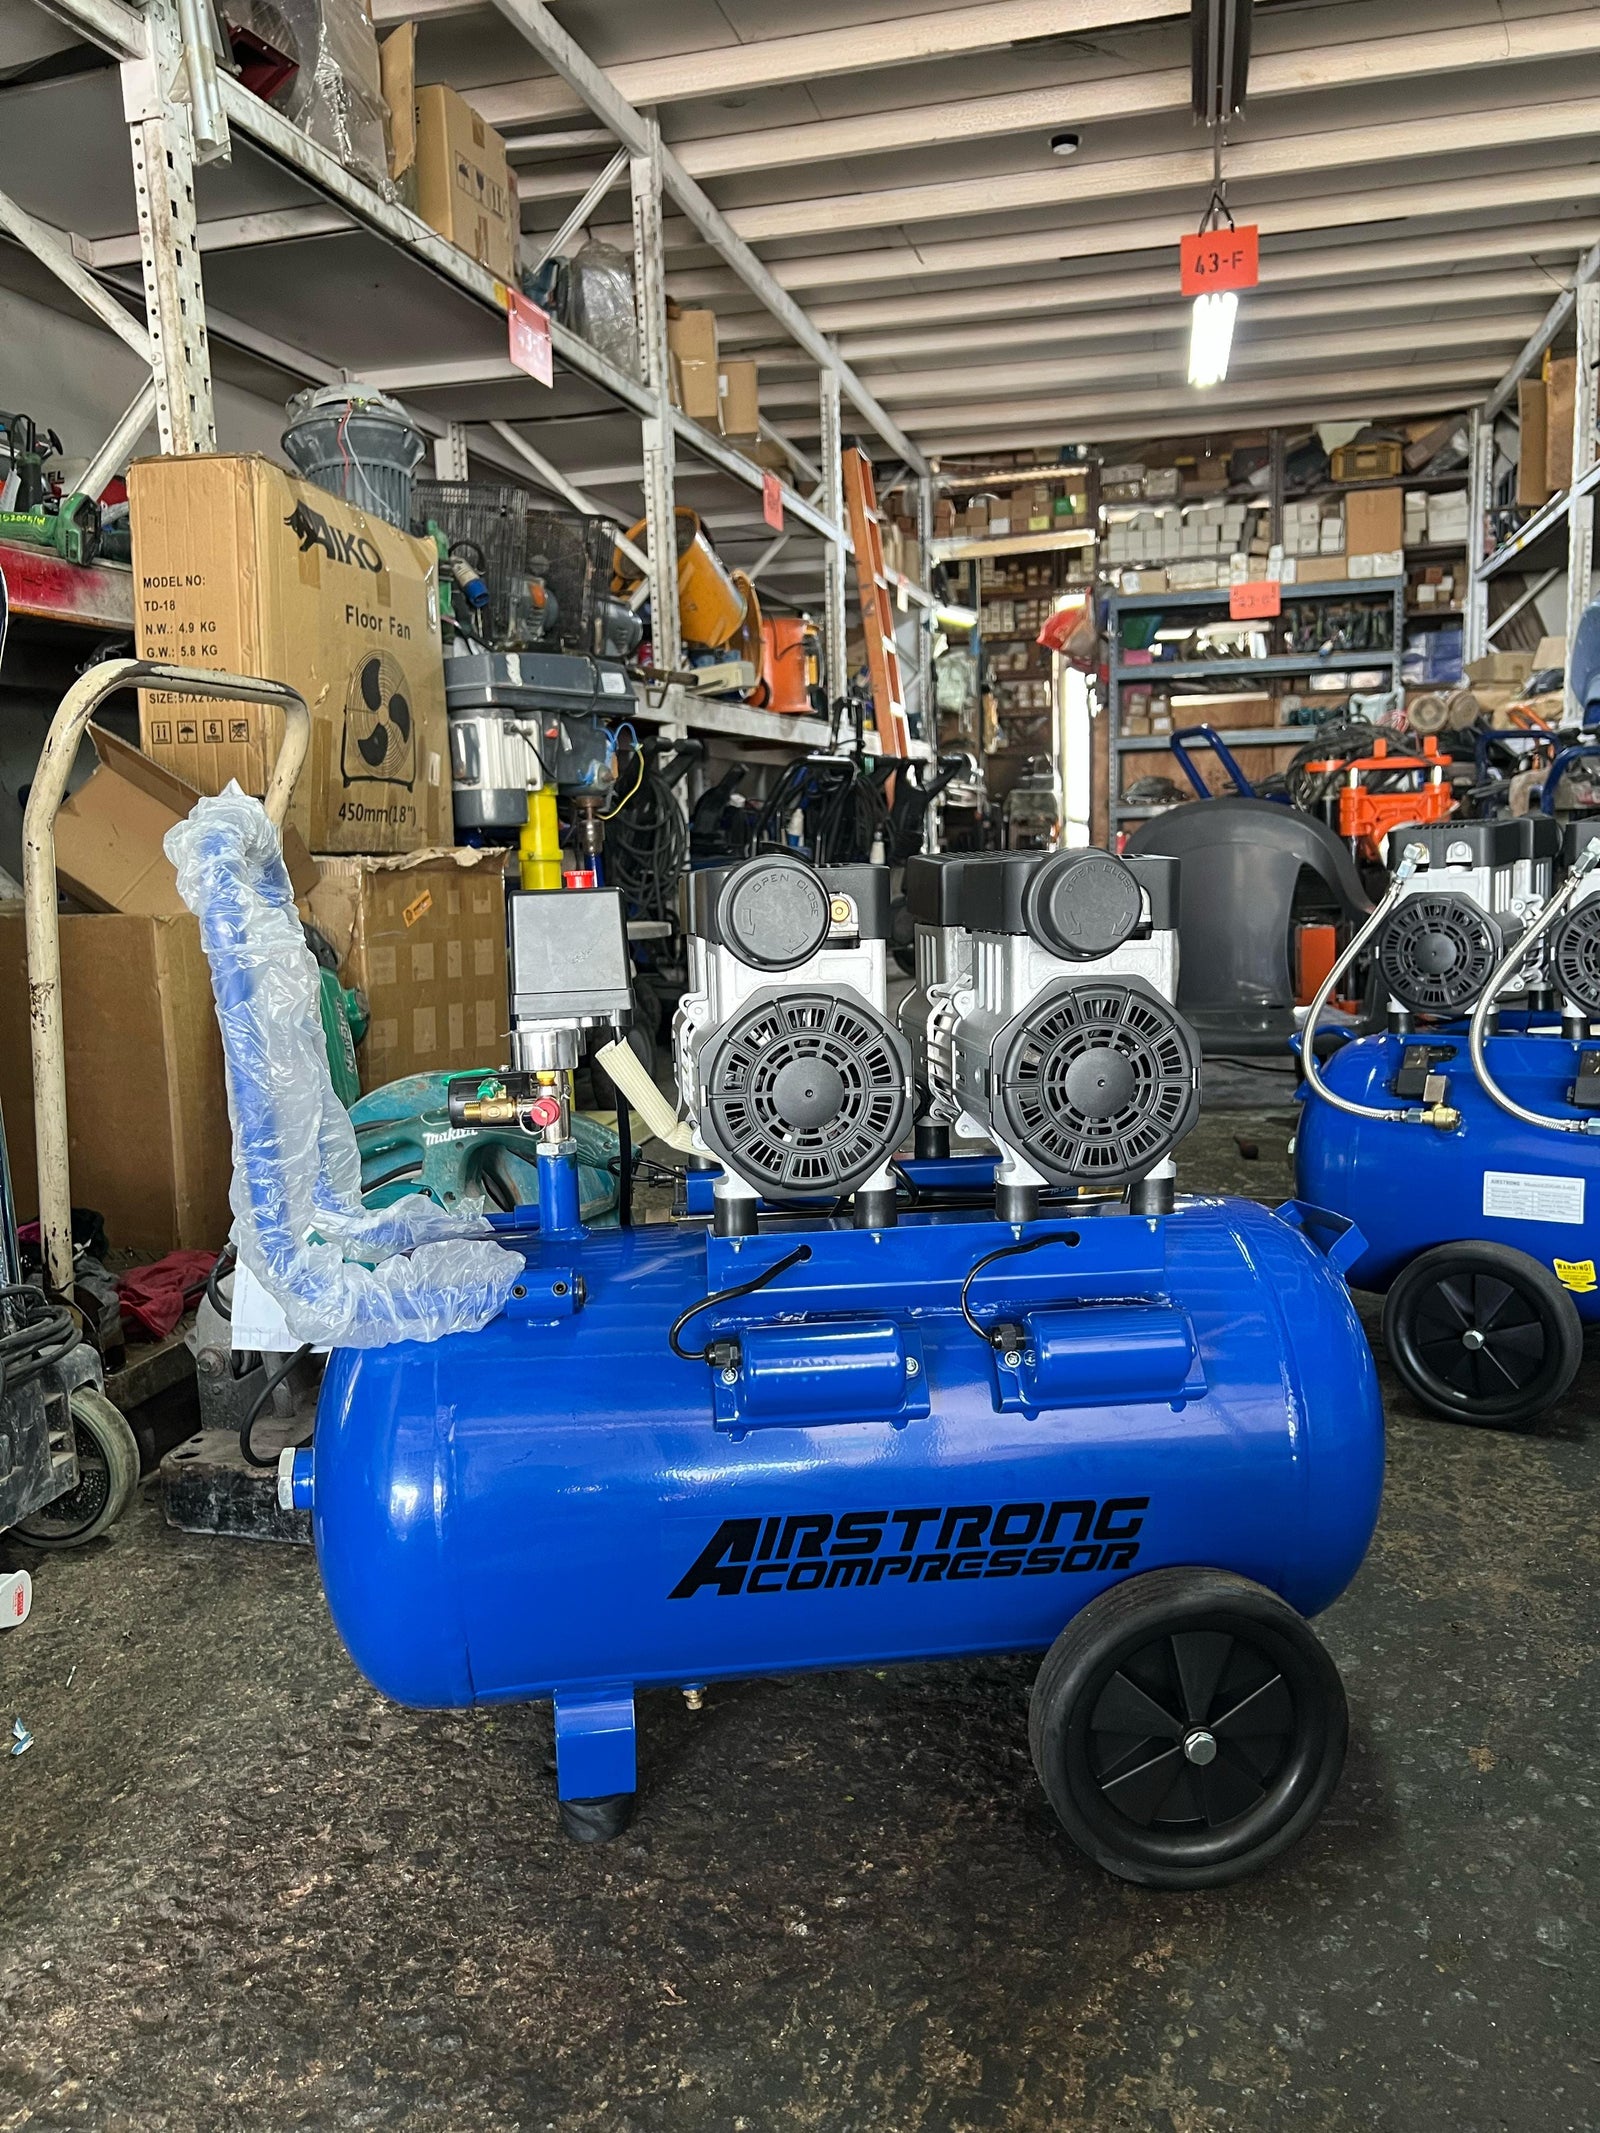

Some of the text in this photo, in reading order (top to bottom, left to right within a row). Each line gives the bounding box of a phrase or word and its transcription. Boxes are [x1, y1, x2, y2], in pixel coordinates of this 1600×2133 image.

[1194, 249, 1245, 276] 43-F
[143, 574, 206, 589] MODEL NO:
[144, 600, 176, 612] TD-18
[145, 621, 217, 636] N.W.: 4.9 KG
[345, 604, 411, 641] Floor Fan
[146, 644, 218, 659] G.W.: 5.8 KG
[338, 802, 417, 828] 450mm(18")
[752, 873, 819, 918] OPEN CLOSE
[666, 1496, 1151, 1600] AIRSTRONG
[746, 1541, 1141, 1595] COMPRESSOR
